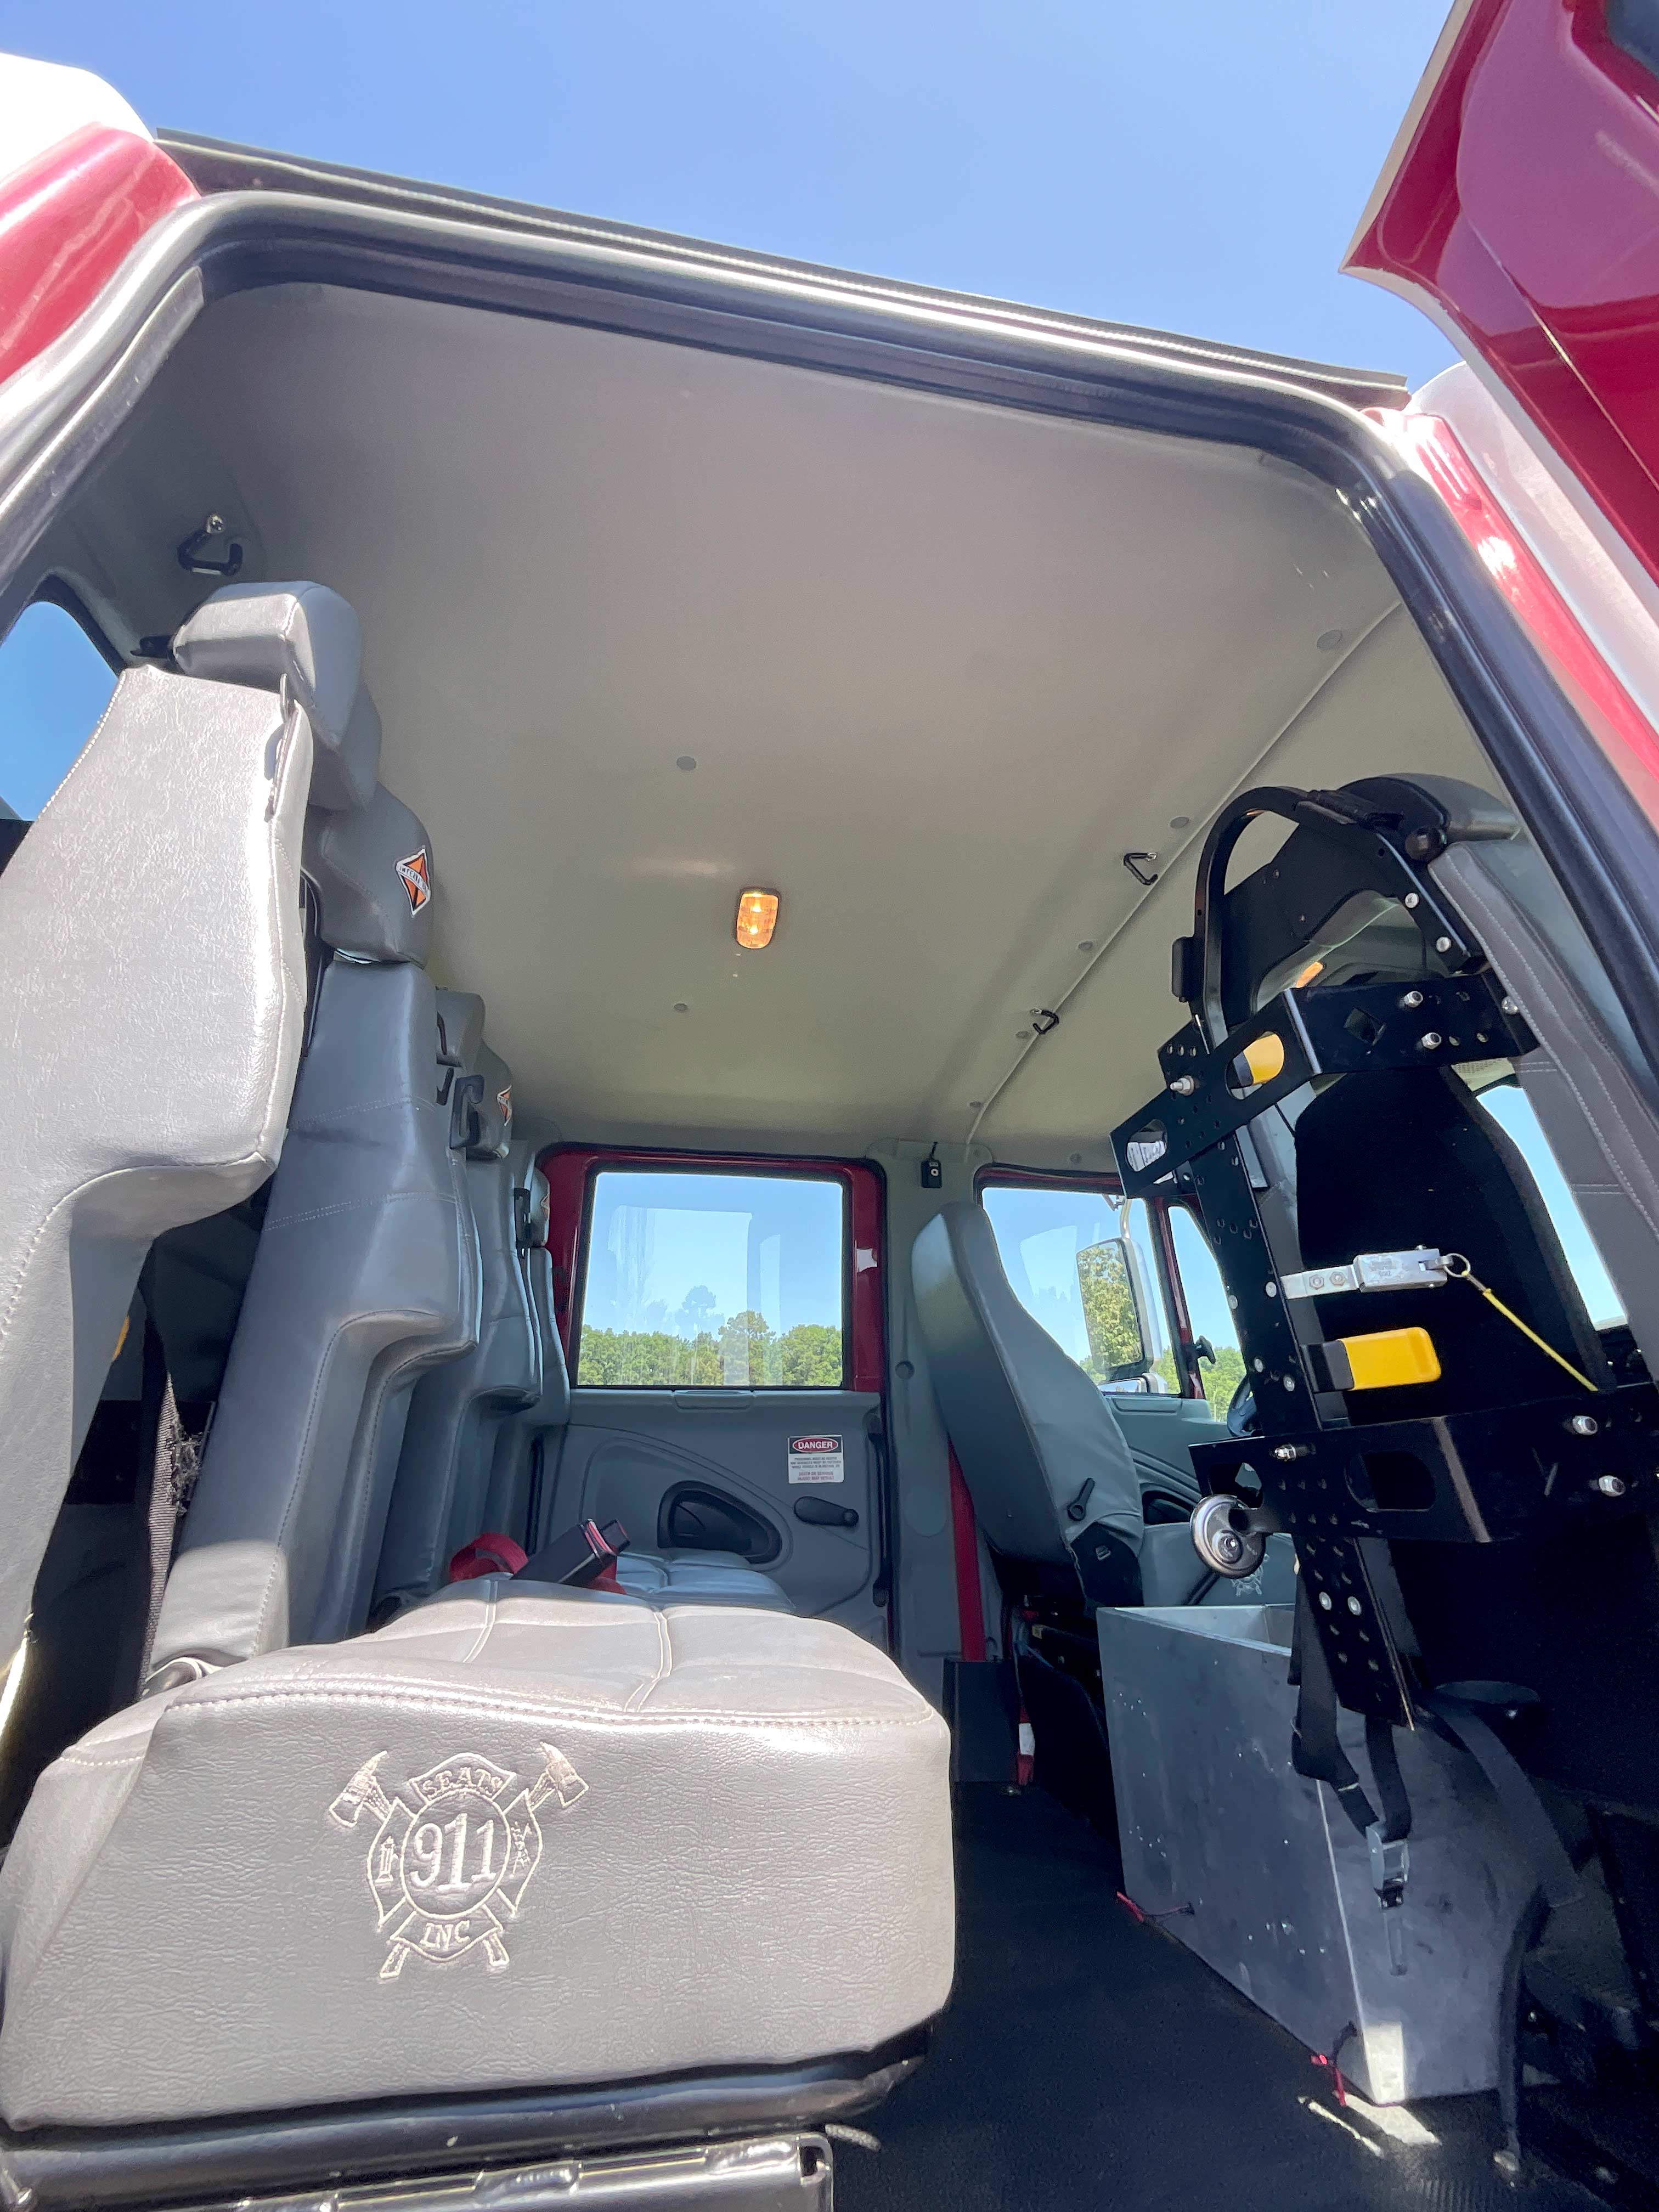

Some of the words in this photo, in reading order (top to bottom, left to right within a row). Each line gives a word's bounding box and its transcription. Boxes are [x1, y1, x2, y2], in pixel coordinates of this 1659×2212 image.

[798, 1441, 833, 1449] DANGER
[410, 1813, 496, 1893] 911
[420, 1920, 471, 1950] INC
